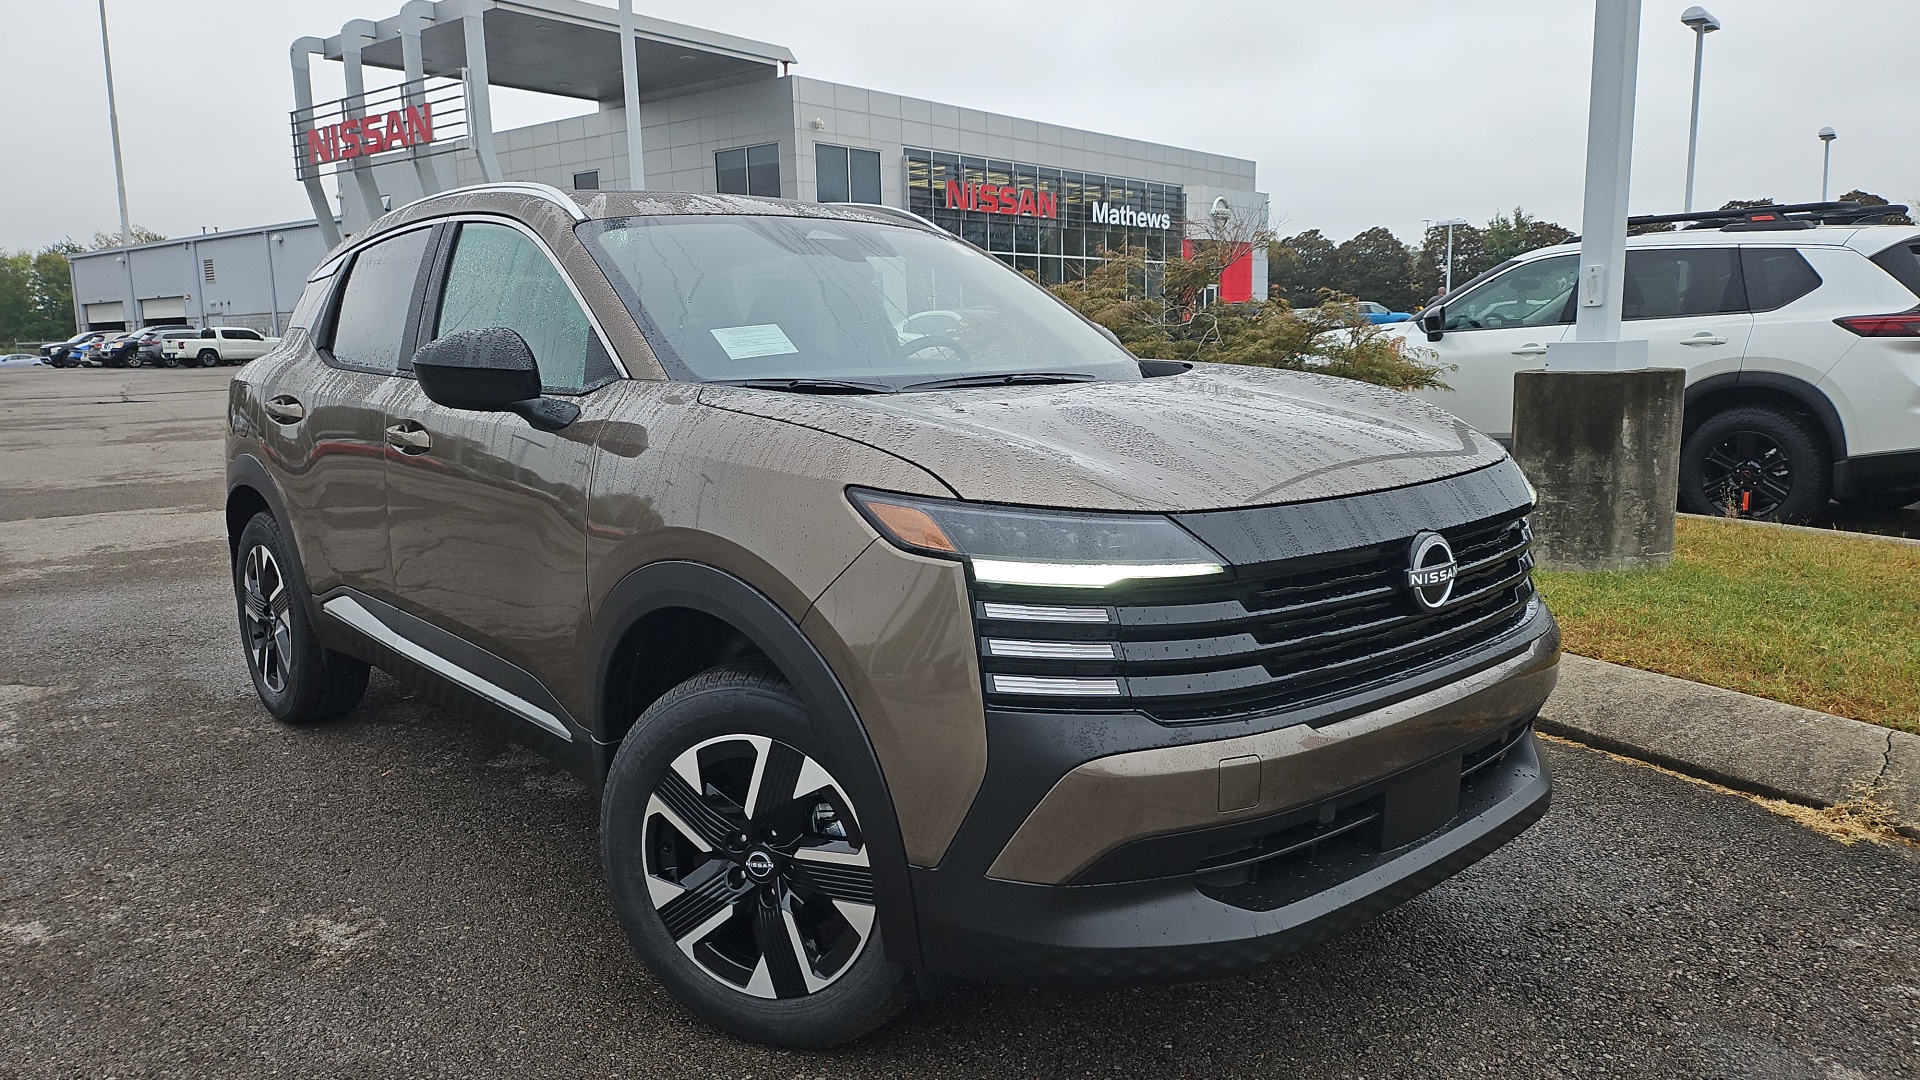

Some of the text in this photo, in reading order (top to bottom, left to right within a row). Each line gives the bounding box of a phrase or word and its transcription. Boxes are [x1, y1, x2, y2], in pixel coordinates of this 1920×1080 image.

[308, 103, 433, 164] NISSAN
[946, 180, 1057, 218] NISSAN
[1091, 201, 1171, 230] Mathews
[1412, 564, 1457, 585] NISSAN
